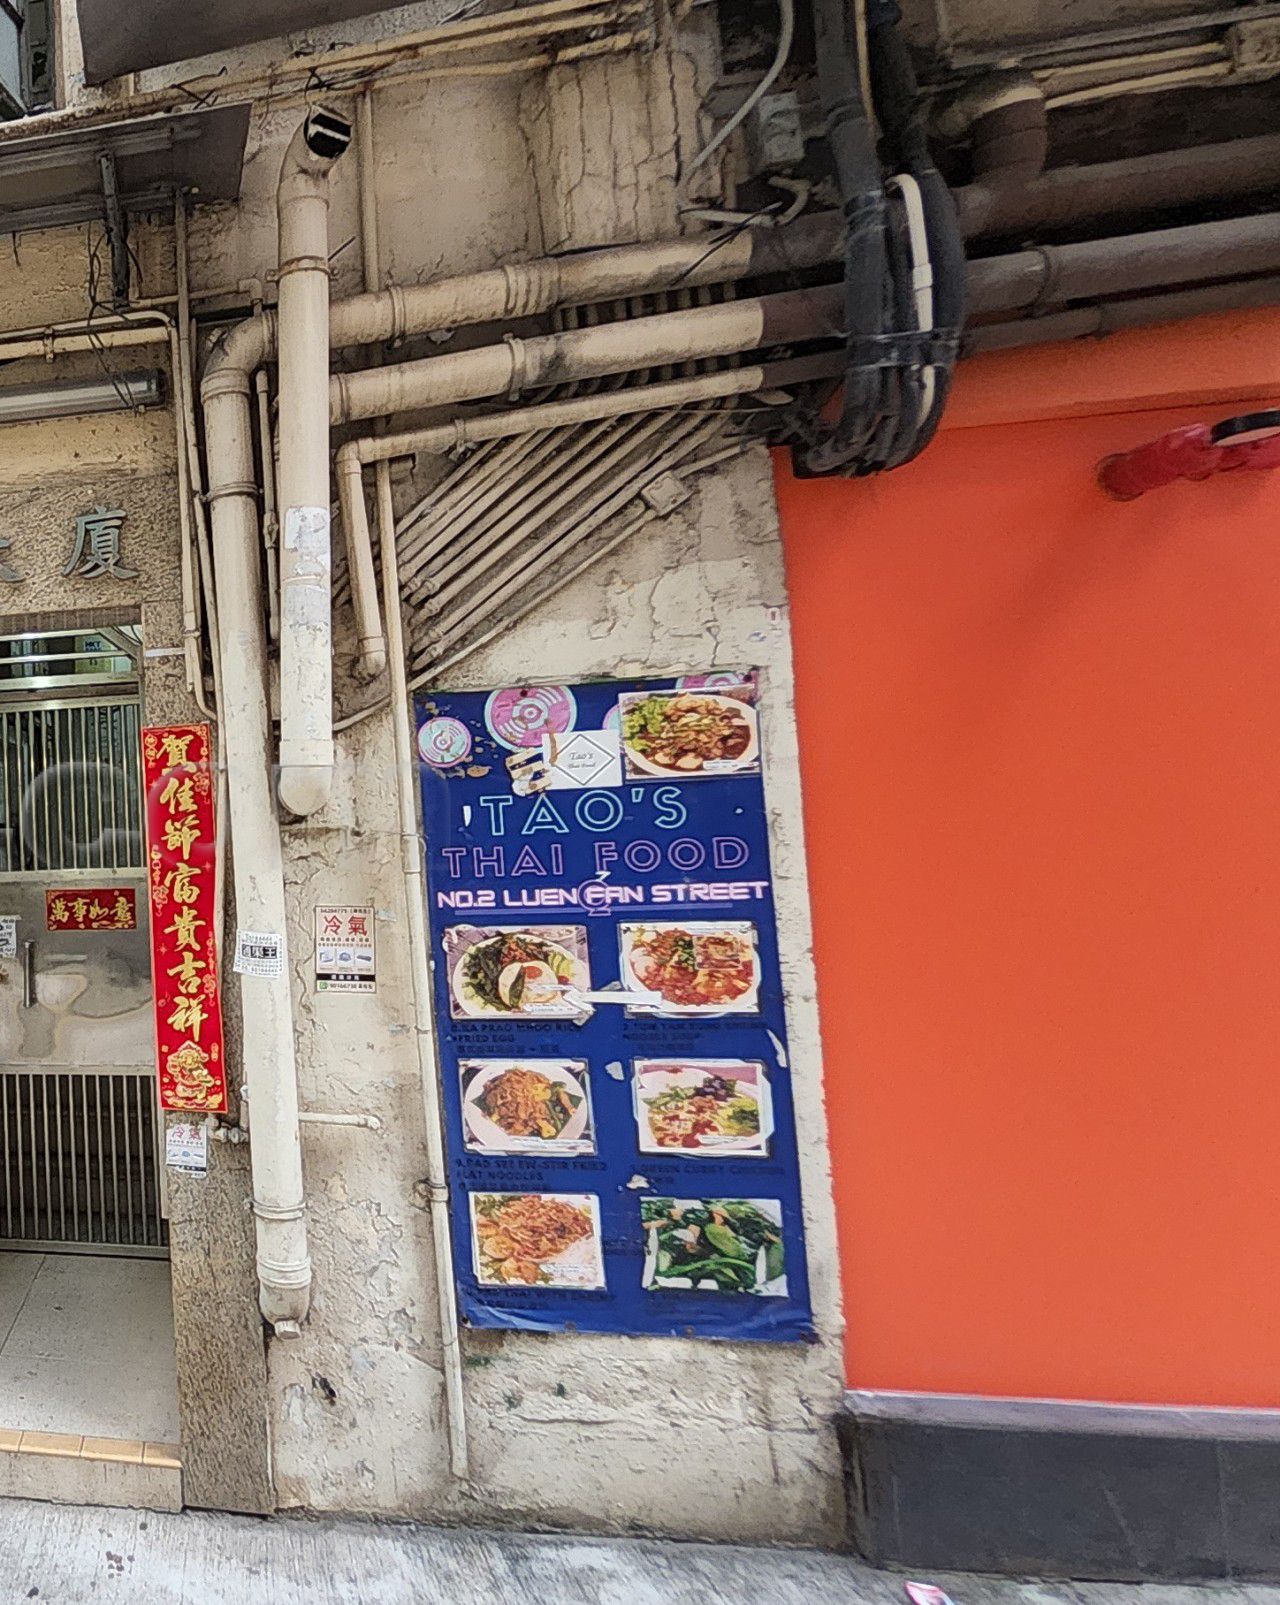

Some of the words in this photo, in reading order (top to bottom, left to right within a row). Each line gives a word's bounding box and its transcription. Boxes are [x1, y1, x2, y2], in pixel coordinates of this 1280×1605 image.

[480, 786, 688, 836] TAO'S
[442, 844, 563, 879] THAI
[595, 837, 750, 872] FOOD
[155, 732, 210, 1044] 賀佳節富貴吉祥
[437, 890, 496, 909] NO.2
[503, 887, 576, 906] LUEN
[651, 881, 769, 902] STREET
[51, 897, 133, 923] 萬事如意
[323, 915, 367, 936] 冷氣
